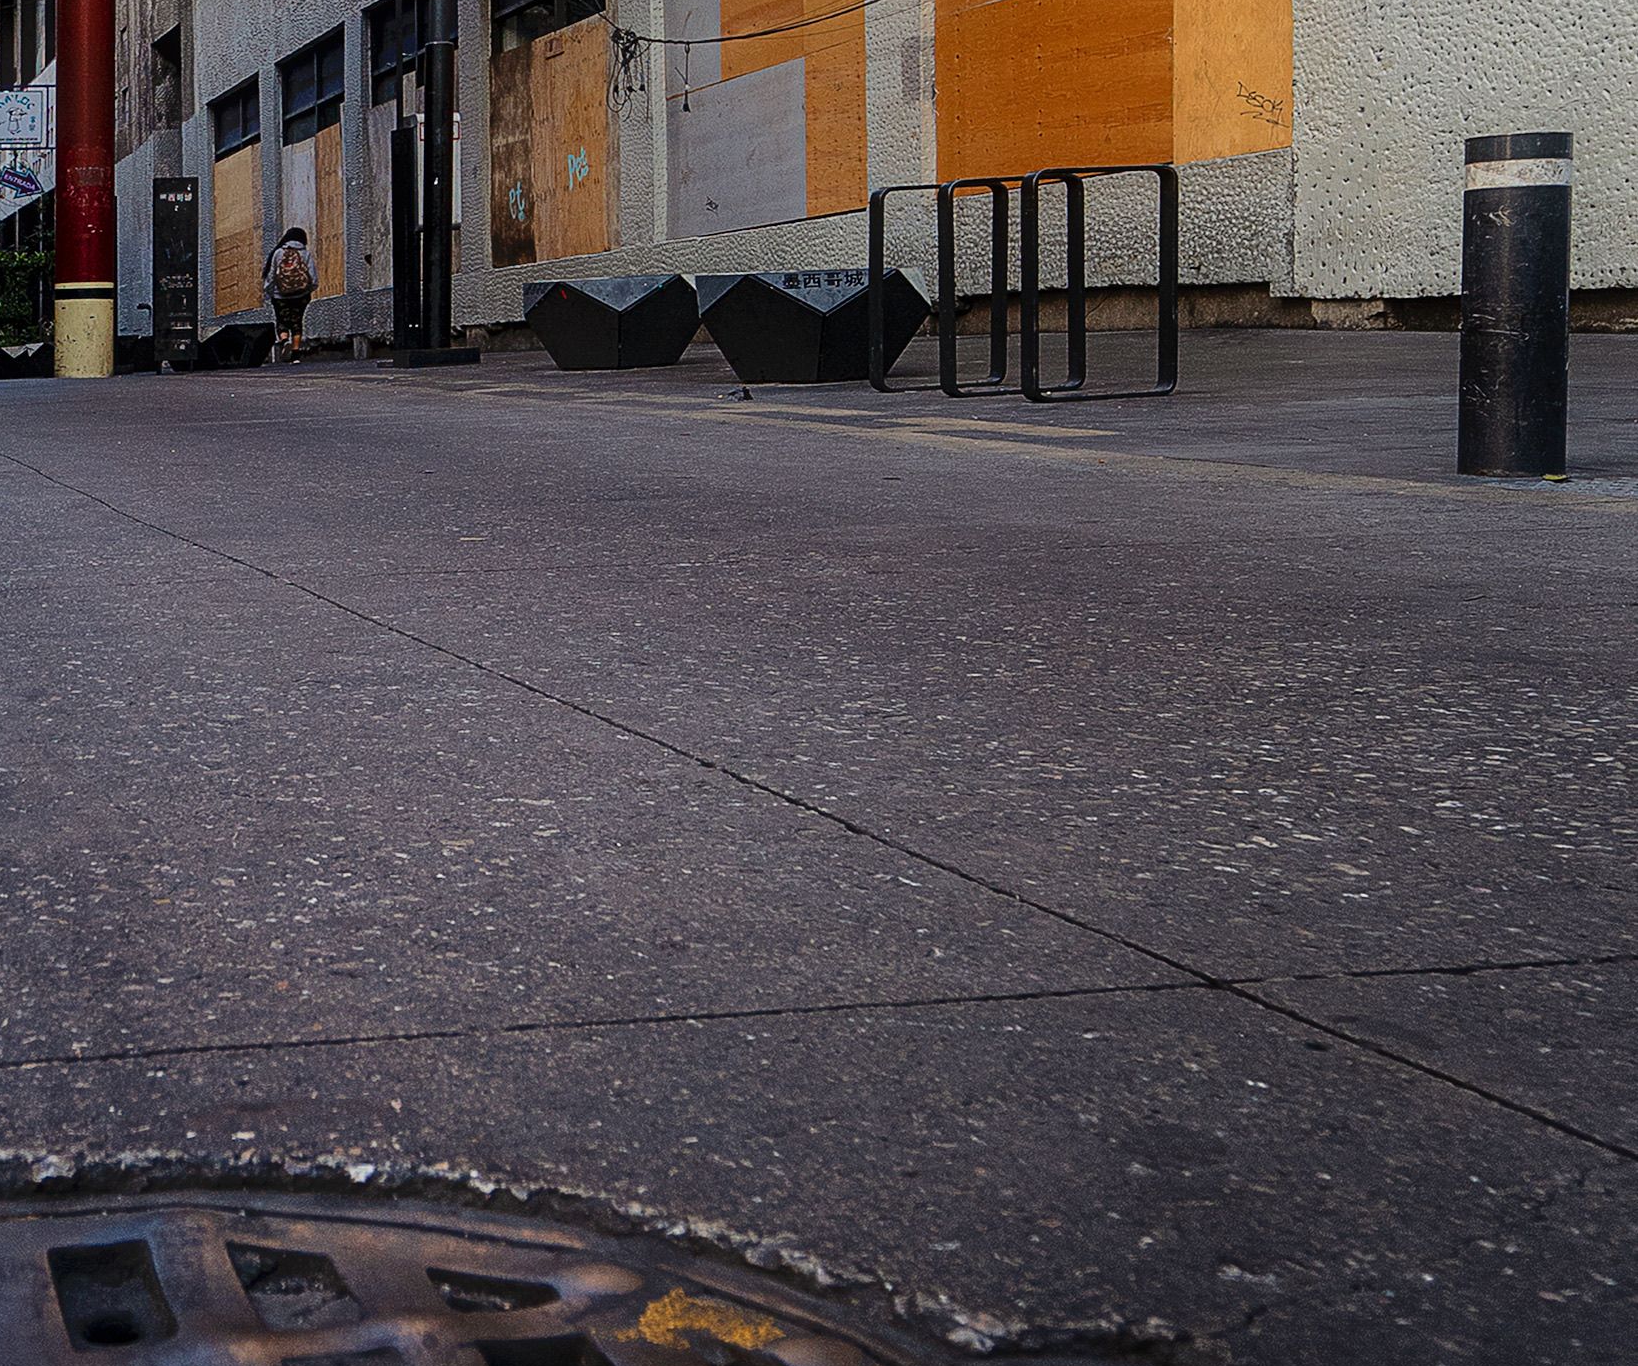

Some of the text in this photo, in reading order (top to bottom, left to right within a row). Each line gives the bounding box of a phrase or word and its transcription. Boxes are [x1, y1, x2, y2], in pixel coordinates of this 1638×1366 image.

[3, 173, 36, 191] ENTRADA
[782, 270, 865, 290] 墨西哥城
